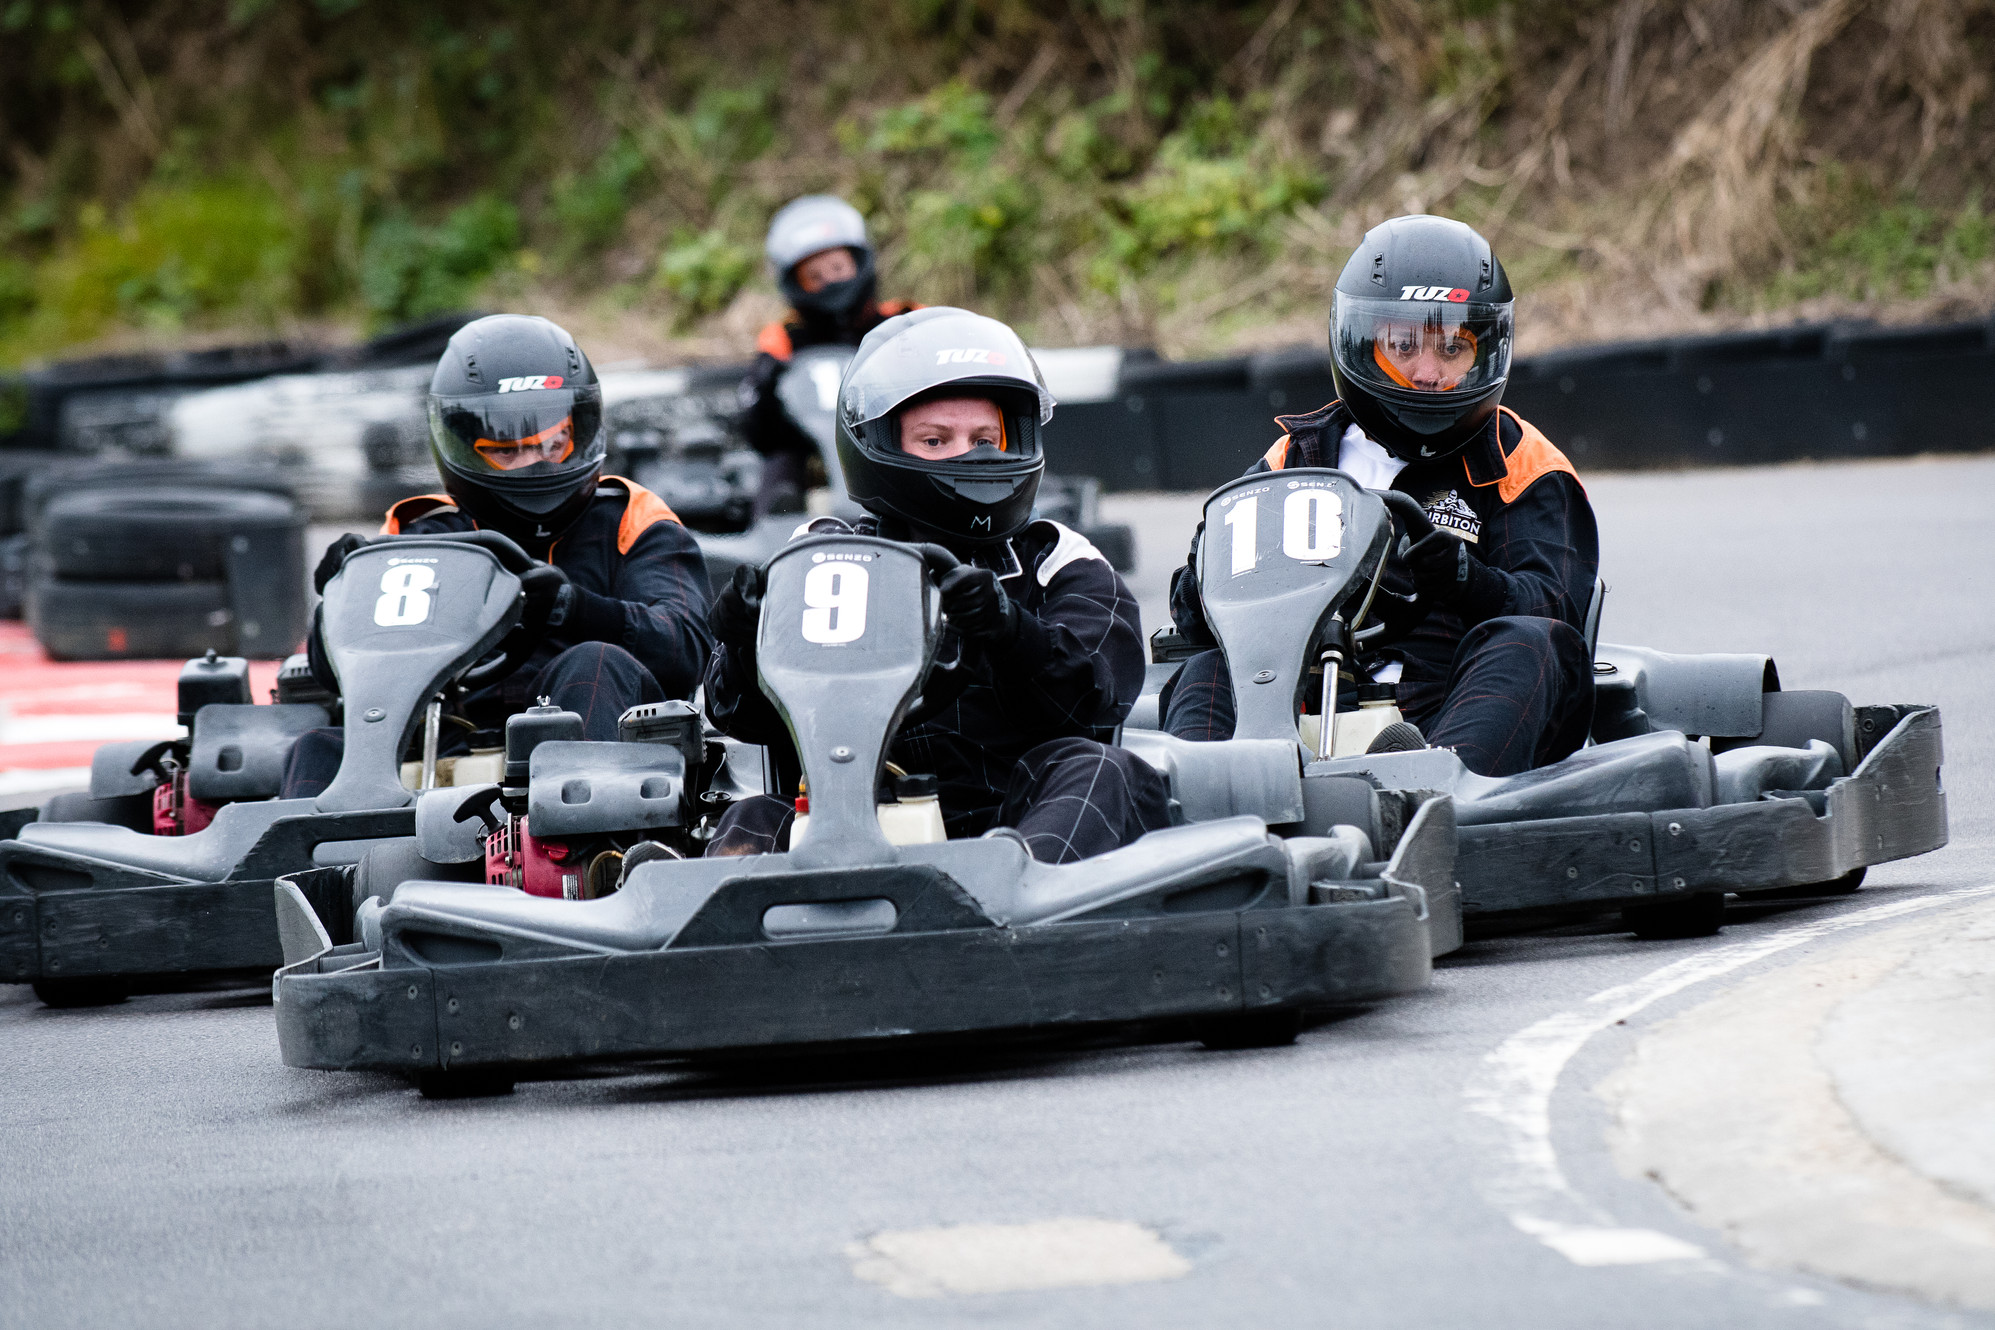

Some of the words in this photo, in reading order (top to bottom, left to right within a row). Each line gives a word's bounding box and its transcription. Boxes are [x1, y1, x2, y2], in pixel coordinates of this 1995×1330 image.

[1400, 285, 1471, 303] TUZO
[936, 348, 1007, 366] TUZO
[497, 375, 564, 394] TUZO
[970, 515, 991, 532] M
[1224, 488, 1344, 576] 10
[1428, 511, 1481, 535] RBITON
[373, 564, 436, 627] 8
[801, 561, 869, 644] 9
